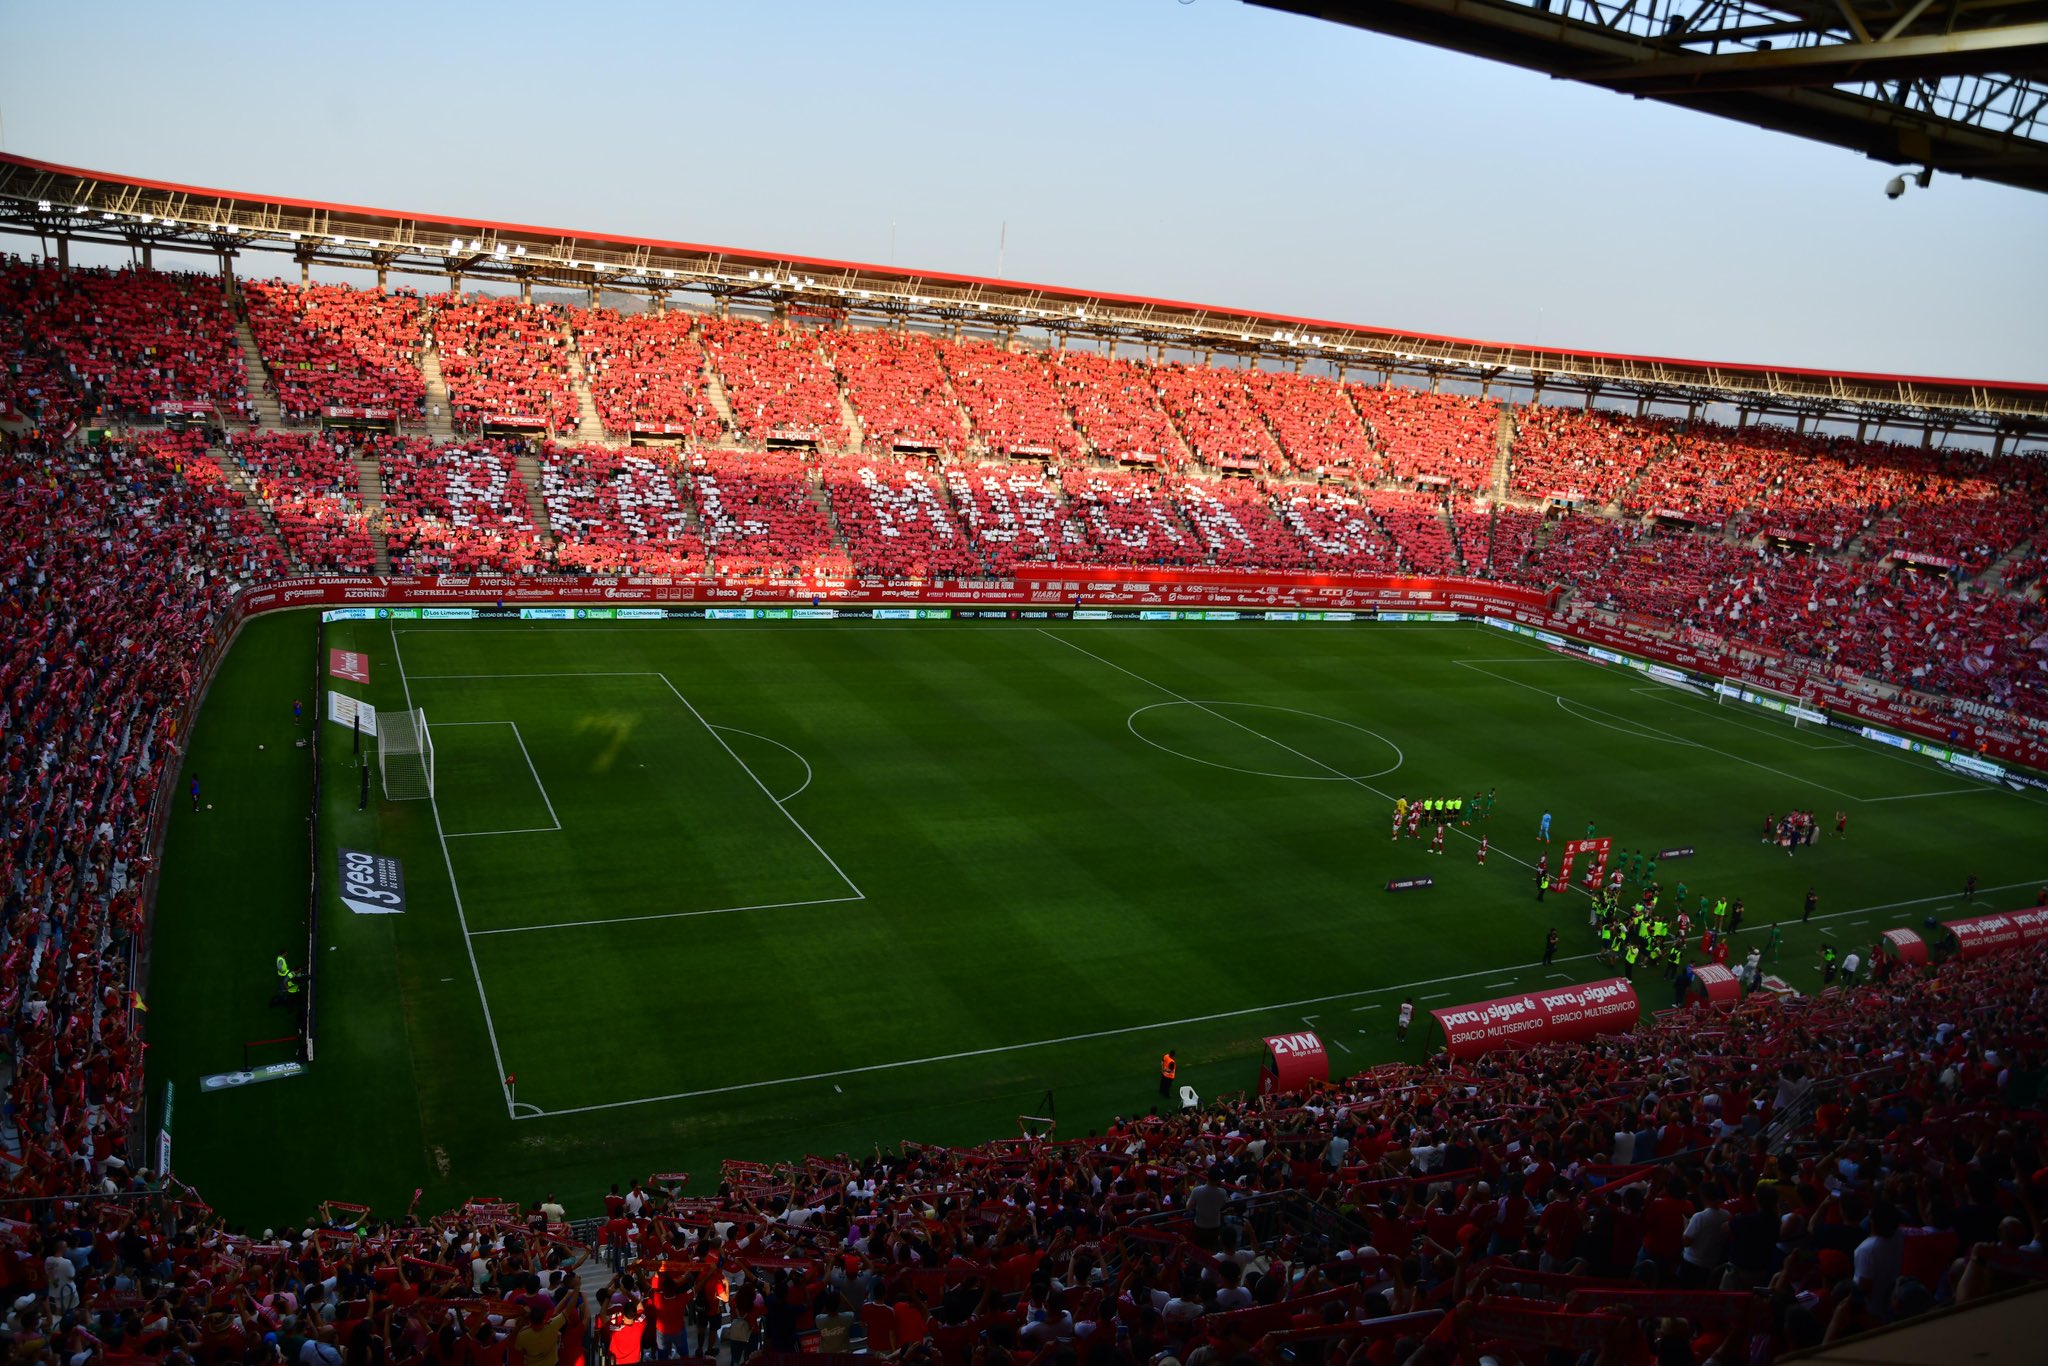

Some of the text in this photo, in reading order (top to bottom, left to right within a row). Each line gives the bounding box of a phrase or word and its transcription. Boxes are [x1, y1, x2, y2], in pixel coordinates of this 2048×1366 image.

[1968, 758, 1997, 773] Limoneros
[1953, 923, 1976, 938] para
[1543, 990, 1577, 1011] para
[1584, 982, 1618, 1003] sigue
[1441, 1008, 1480, 1031] para
[1489, 1001, 1525, 1021] sigue
[1551, 1000, 1636, 1026] ESPACIO MULTISERVICIO
[1269, 1033, 1321, 1054] 2VM
[1451, 1017, 1545, 1044] ESPACIO MULTISERVICIO
